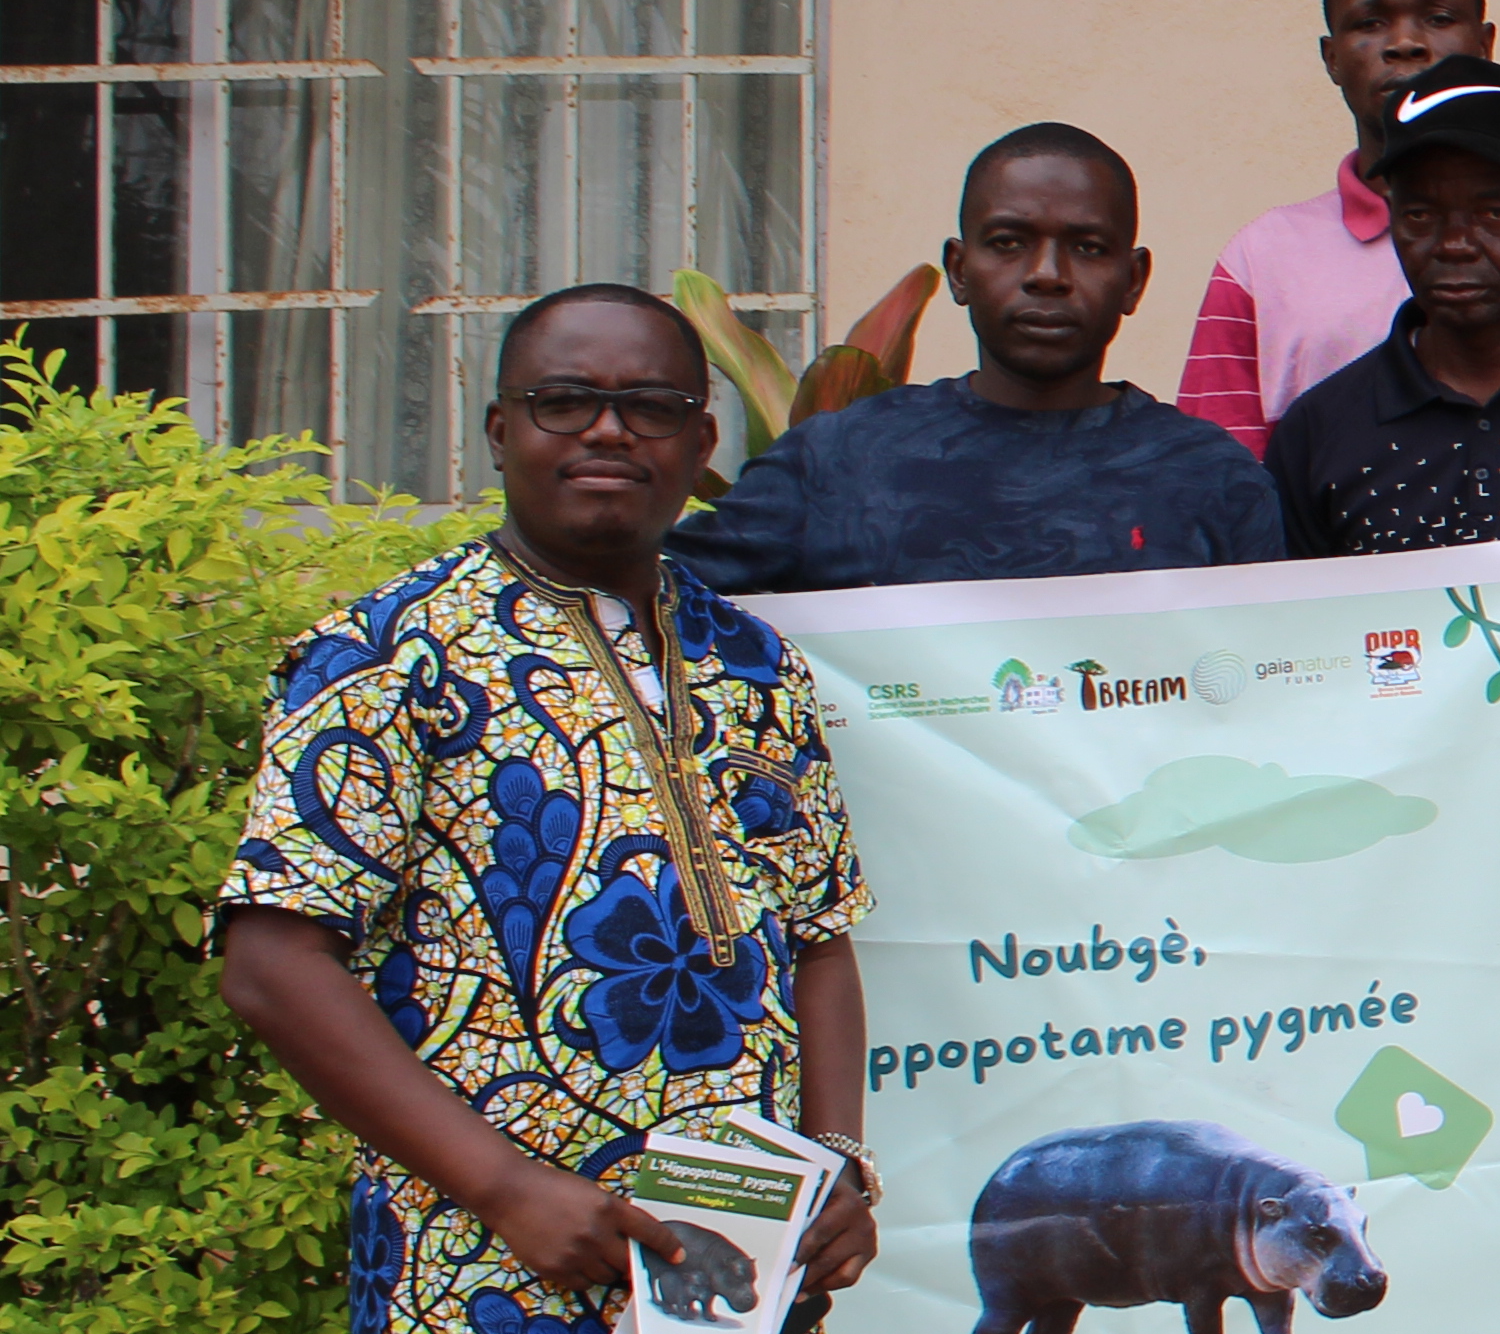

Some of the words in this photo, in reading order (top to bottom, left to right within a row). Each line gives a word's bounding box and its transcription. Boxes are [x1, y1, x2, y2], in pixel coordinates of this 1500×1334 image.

[868, 683, 921, 700] CSRS
[1285, 674, 1325, 685] FUND
[969, 917, 1208, 984] Noubgè,
[1210, 980, 1418, 1063] pygmée
[650, 1157, 742, 1183] L'Hippopotame
[744, 1171, 793, 1194] pygmée
